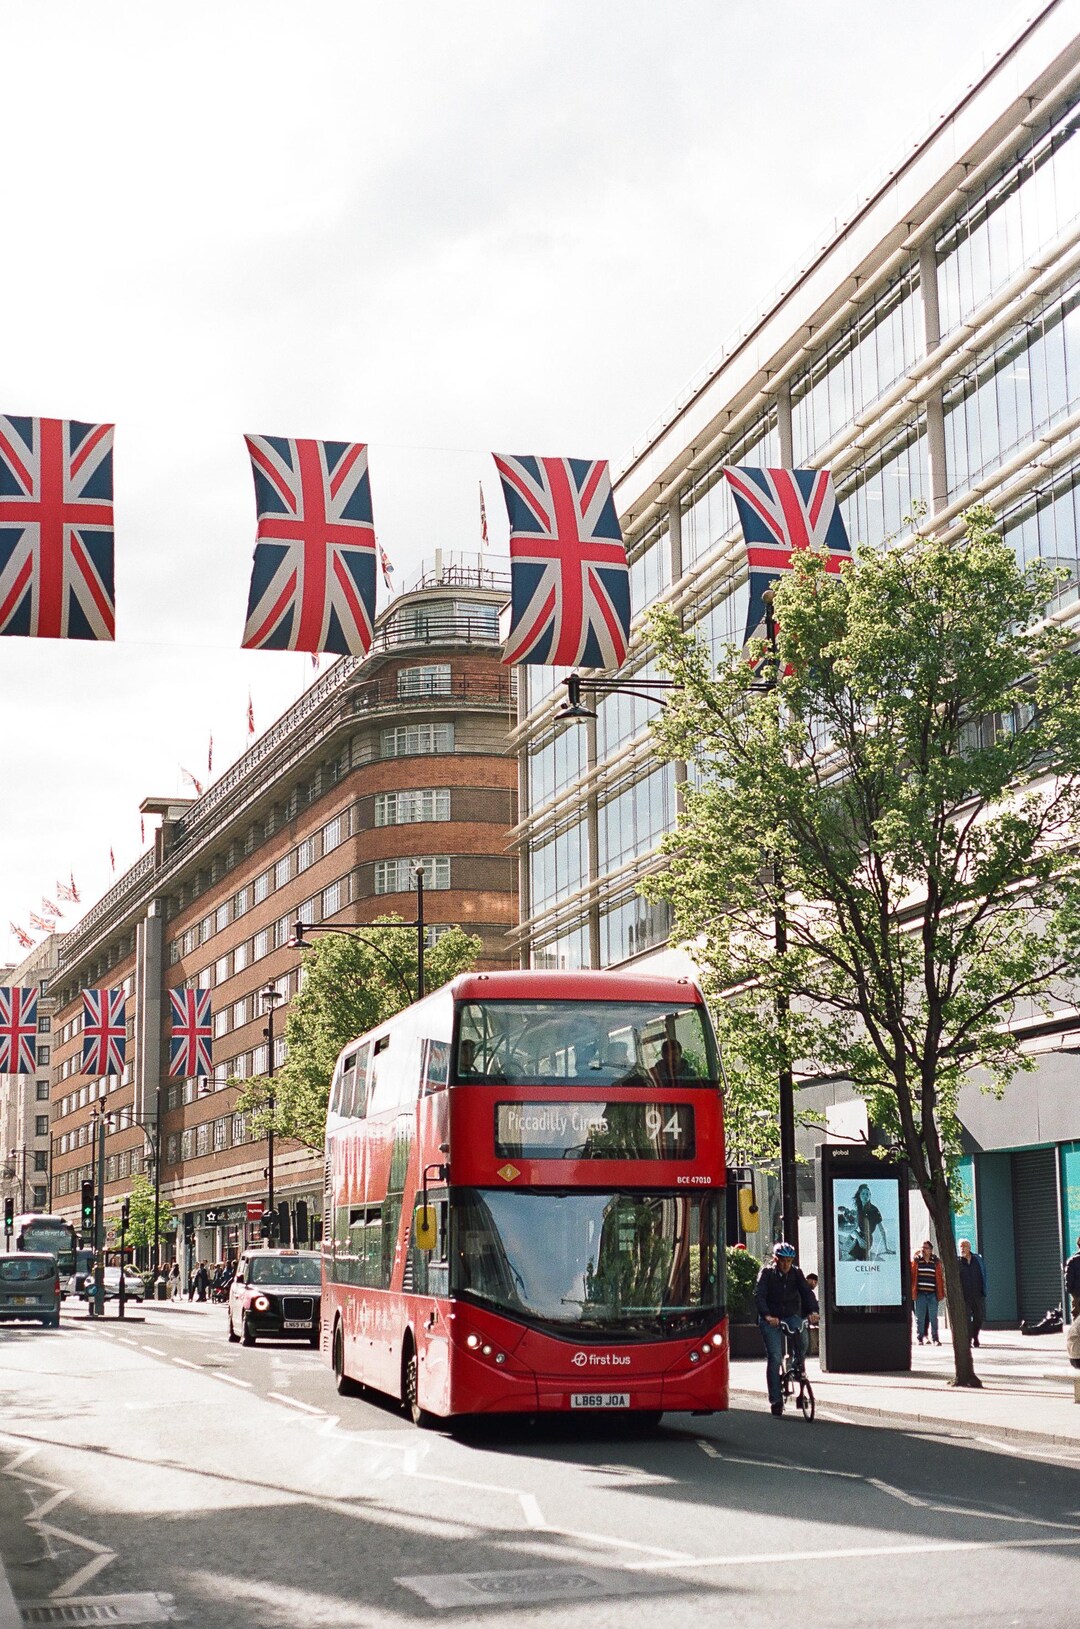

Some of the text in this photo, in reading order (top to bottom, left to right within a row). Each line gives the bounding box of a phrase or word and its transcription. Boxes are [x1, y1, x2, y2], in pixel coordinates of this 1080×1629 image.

[508, 1111, 567, 1136] Piccadilly
[646, 1111, 682, 1140] 94
[832, 1149, 849, 1157] global
[677, 1176, 712, 1184] BCE 47010
[589, 1354, 631, 1365] first bus
[575, 1395, 625, 1406] LB69 JOA
